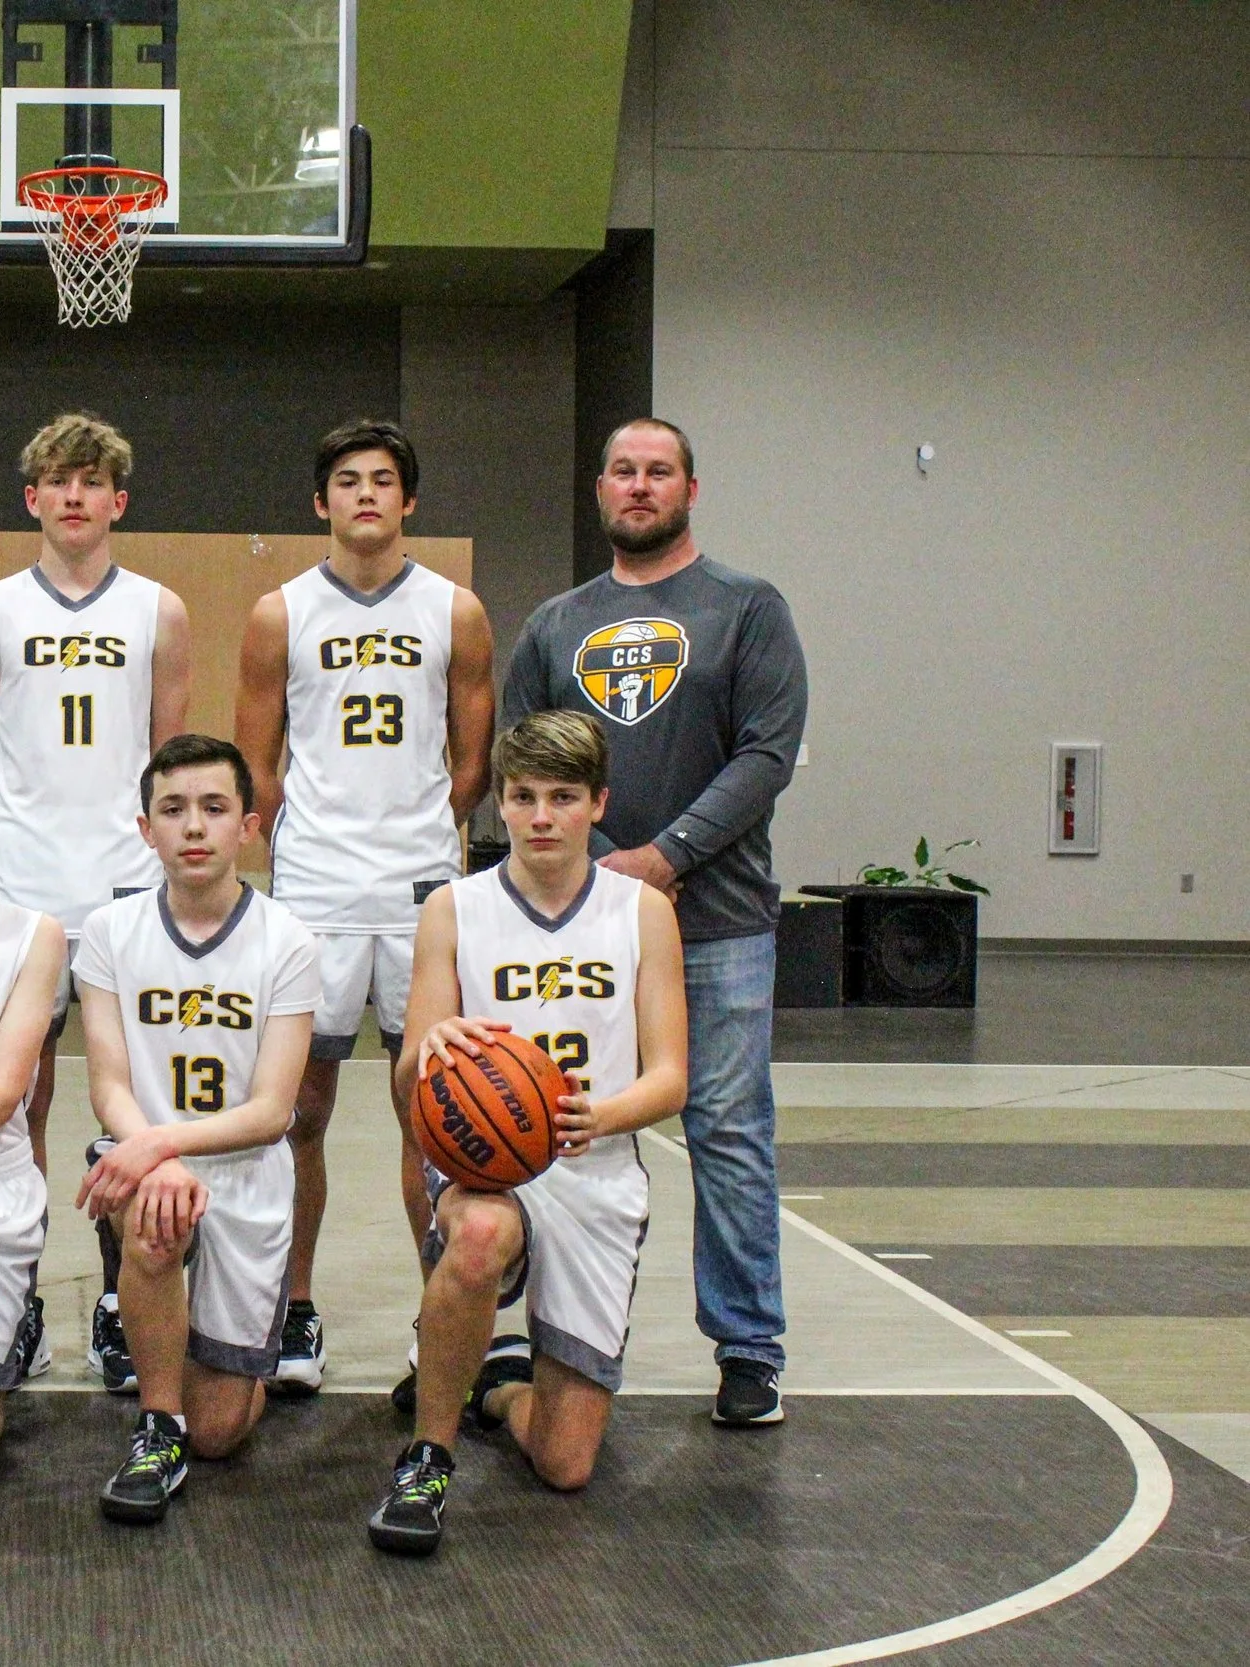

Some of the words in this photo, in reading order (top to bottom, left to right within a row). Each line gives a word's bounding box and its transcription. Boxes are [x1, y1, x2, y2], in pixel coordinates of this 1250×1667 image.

[22, 634, 127, 668] CCS
[318, 633, 423, 671] CCS
[611, 645, 653, 667] CCS
[59, 693, 94, 747] 11
[341, 692, 404, 748] 23
[492, 959, 617, 1001] CCS
[137, 987, 254, 1030] CCS
[171, 1053, 225, 1114] 13
[430, 1067, 496, 1168] Wilson
